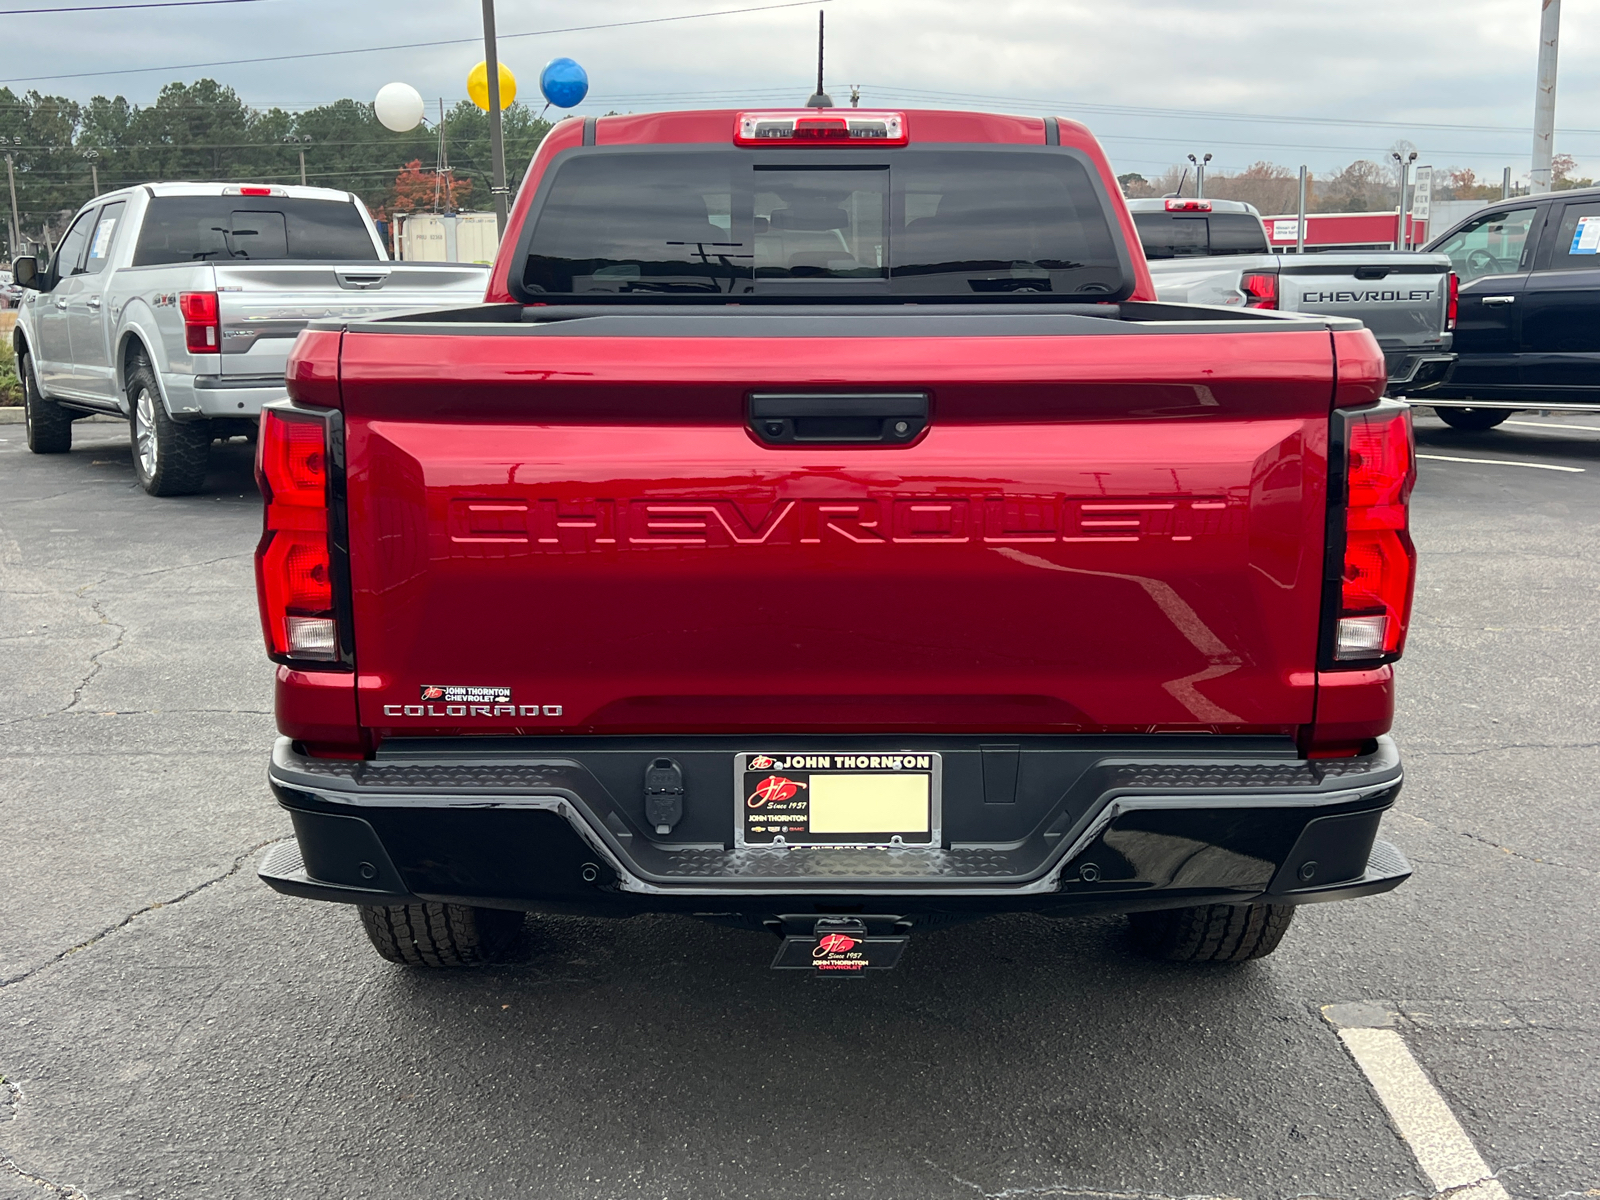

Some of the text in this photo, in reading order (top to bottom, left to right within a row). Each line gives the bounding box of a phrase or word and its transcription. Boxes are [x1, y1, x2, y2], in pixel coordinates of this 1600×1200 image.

[1302, 290, 1435, 303] CHEVROLET
[450, 496, 1227, 544] CHEVROLET
[445, 687, 466, 695] JOHN
[467, 688, 510, 696] THORNTON
[445, 694, 495, 702] CHEVROLET
[383, 704, 563, 717] COLORADO
[783, 756, 830, 769] JOHN
[834, 756, 930, 769] THORNTON
[766, 801, 808, 810] Since 1957
[748, 814, 808, 822] JOHN THORNTON
